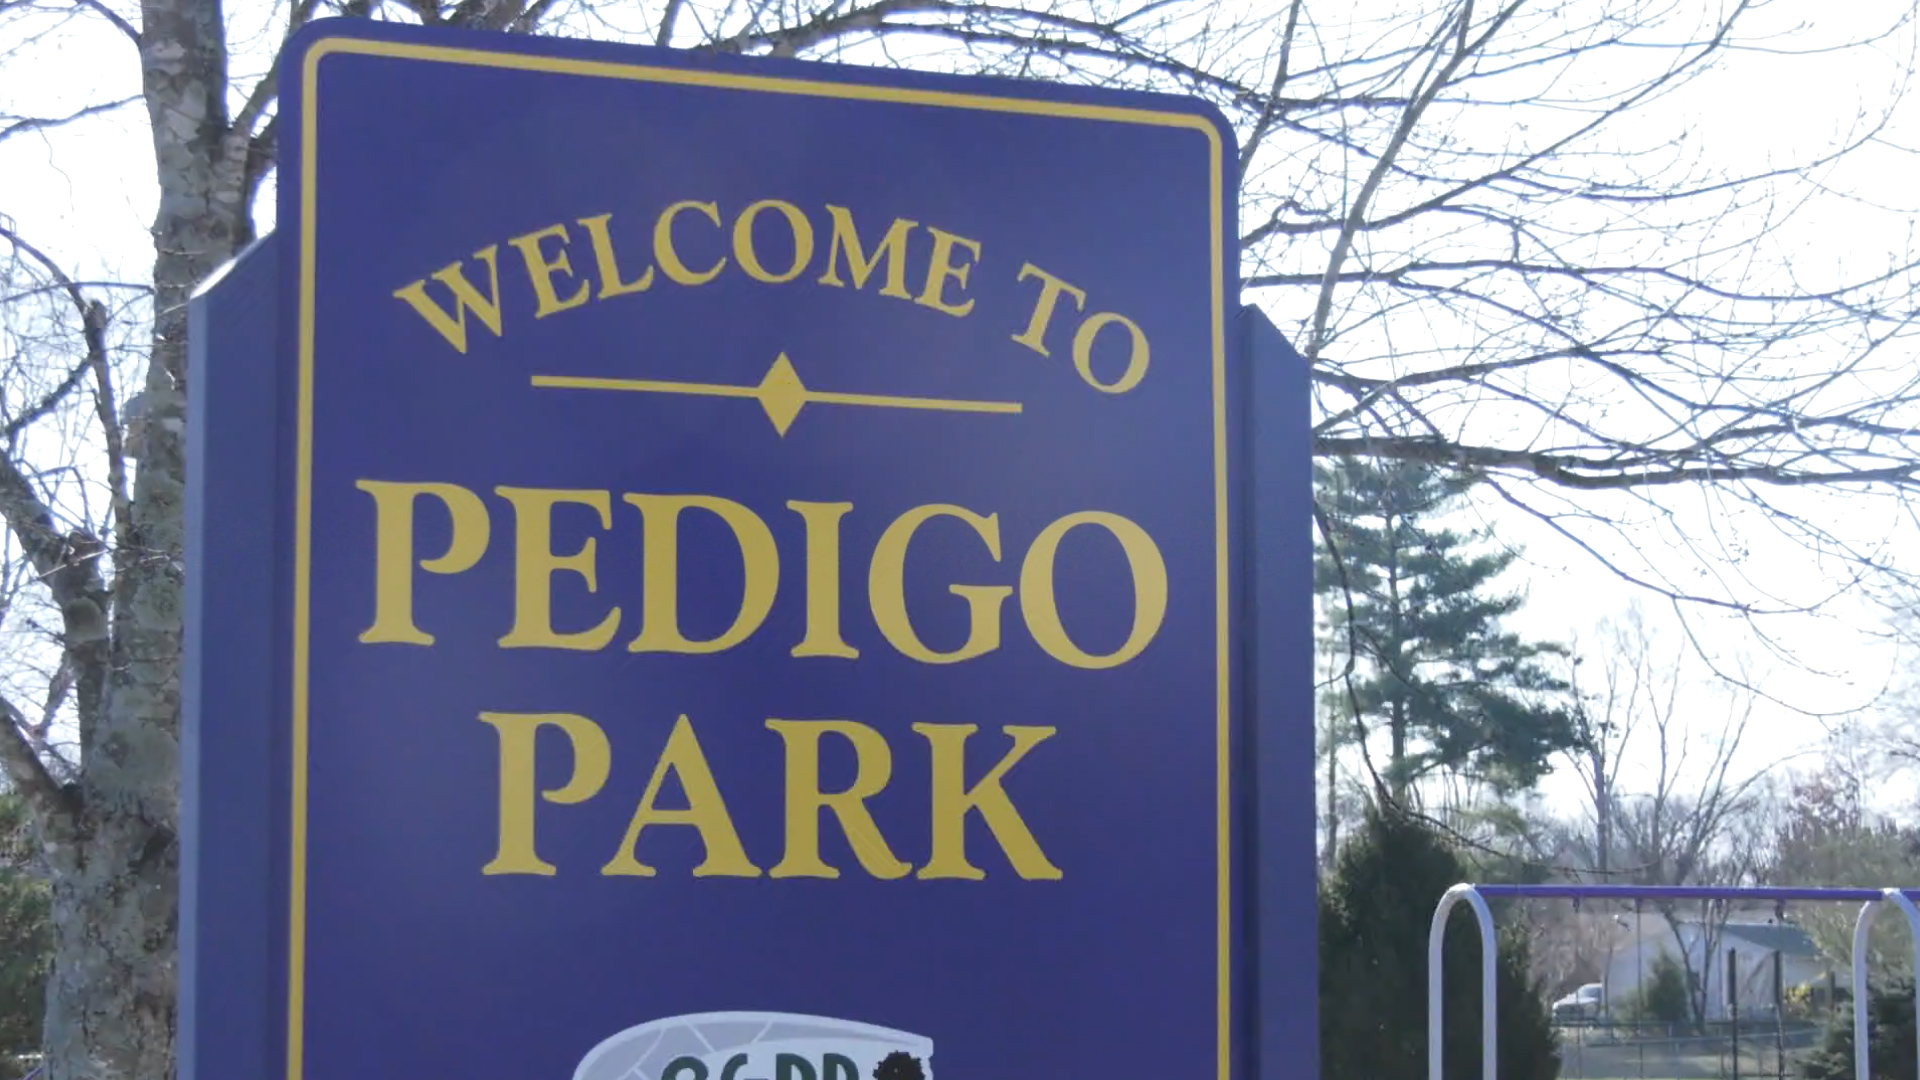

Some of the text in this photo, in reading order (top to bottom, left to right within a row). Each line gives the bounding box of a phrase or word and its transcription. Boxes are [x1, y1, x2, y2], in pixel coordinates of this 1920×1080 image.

[393, 199, 1150, 395] WELCOME TO
[355, 478, 1169, 670] PEDIGO
[478, 711, 1064, 881] PARK
